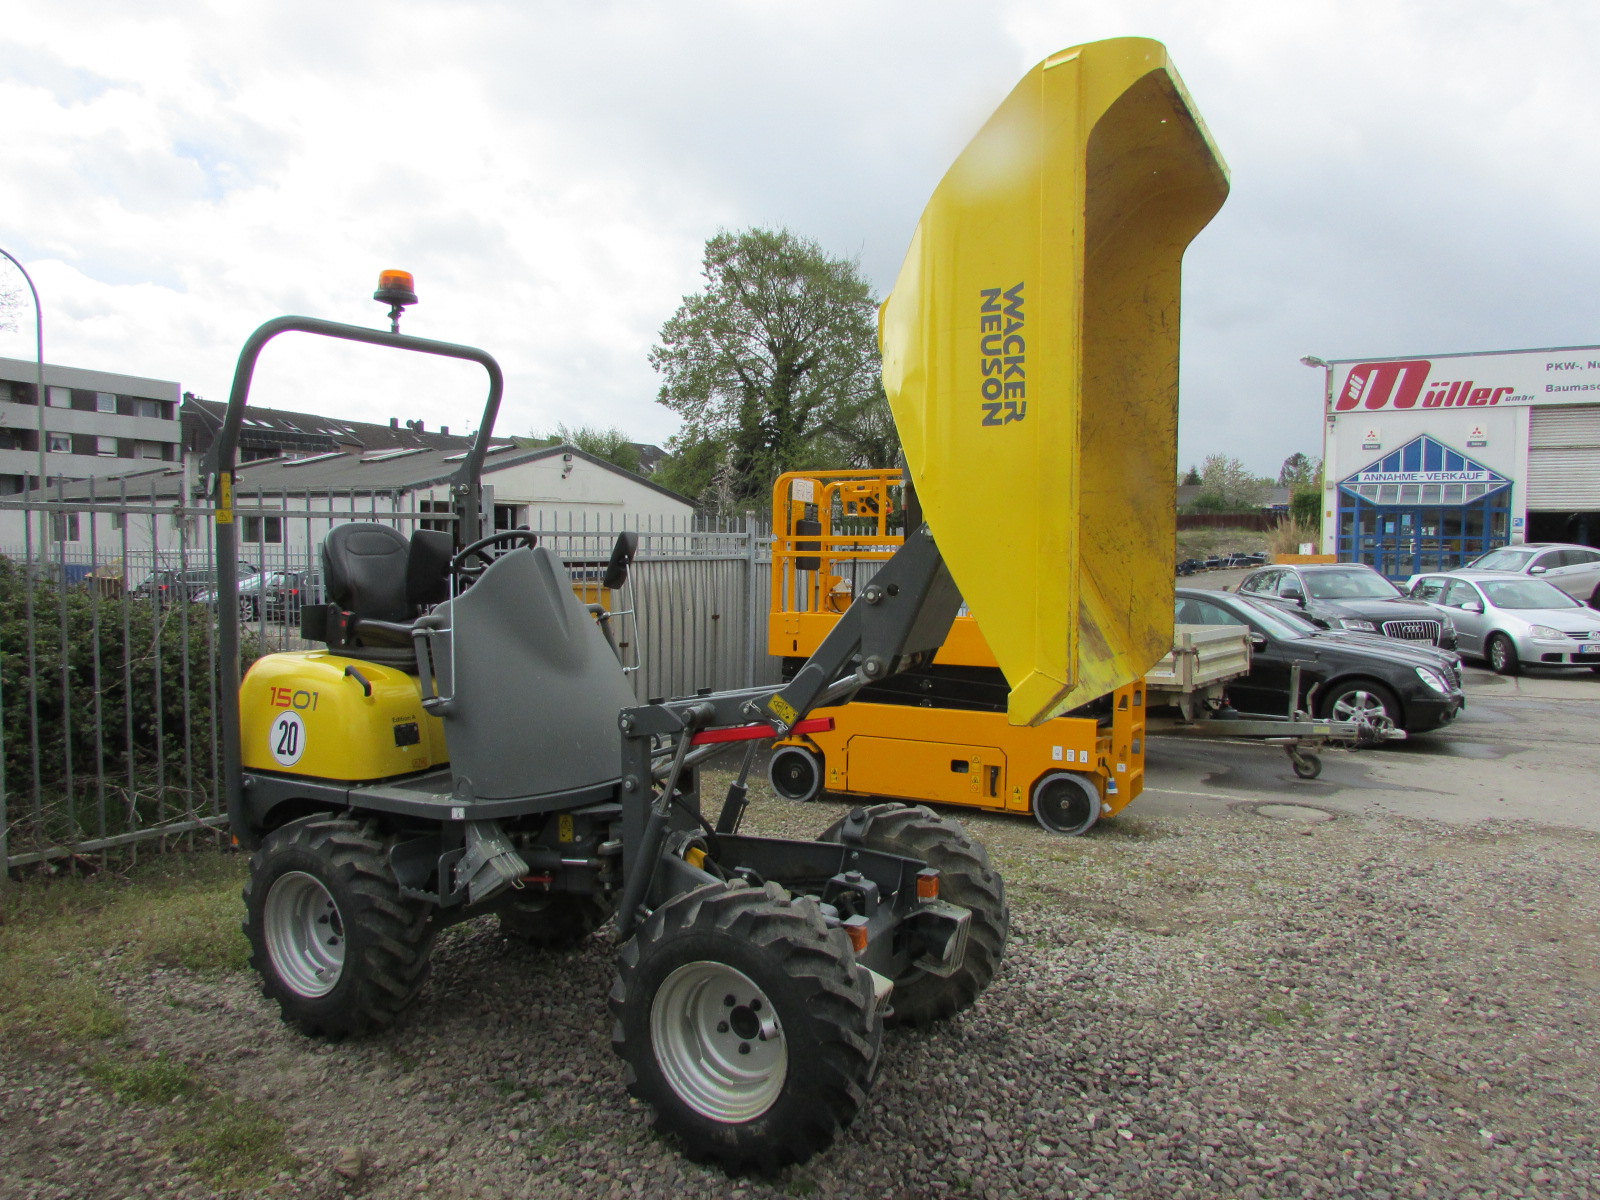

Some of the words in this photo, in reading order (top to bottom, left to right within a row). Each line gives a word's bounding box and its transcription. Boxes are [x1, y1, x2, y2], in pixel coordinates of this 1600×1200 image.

[980, 287, 1003, 427] NEUSON
[1002, 281, 1027, 426] WACKER
[270, 686, 319, 711] 1501
[276, 720, 299, 756] 20
